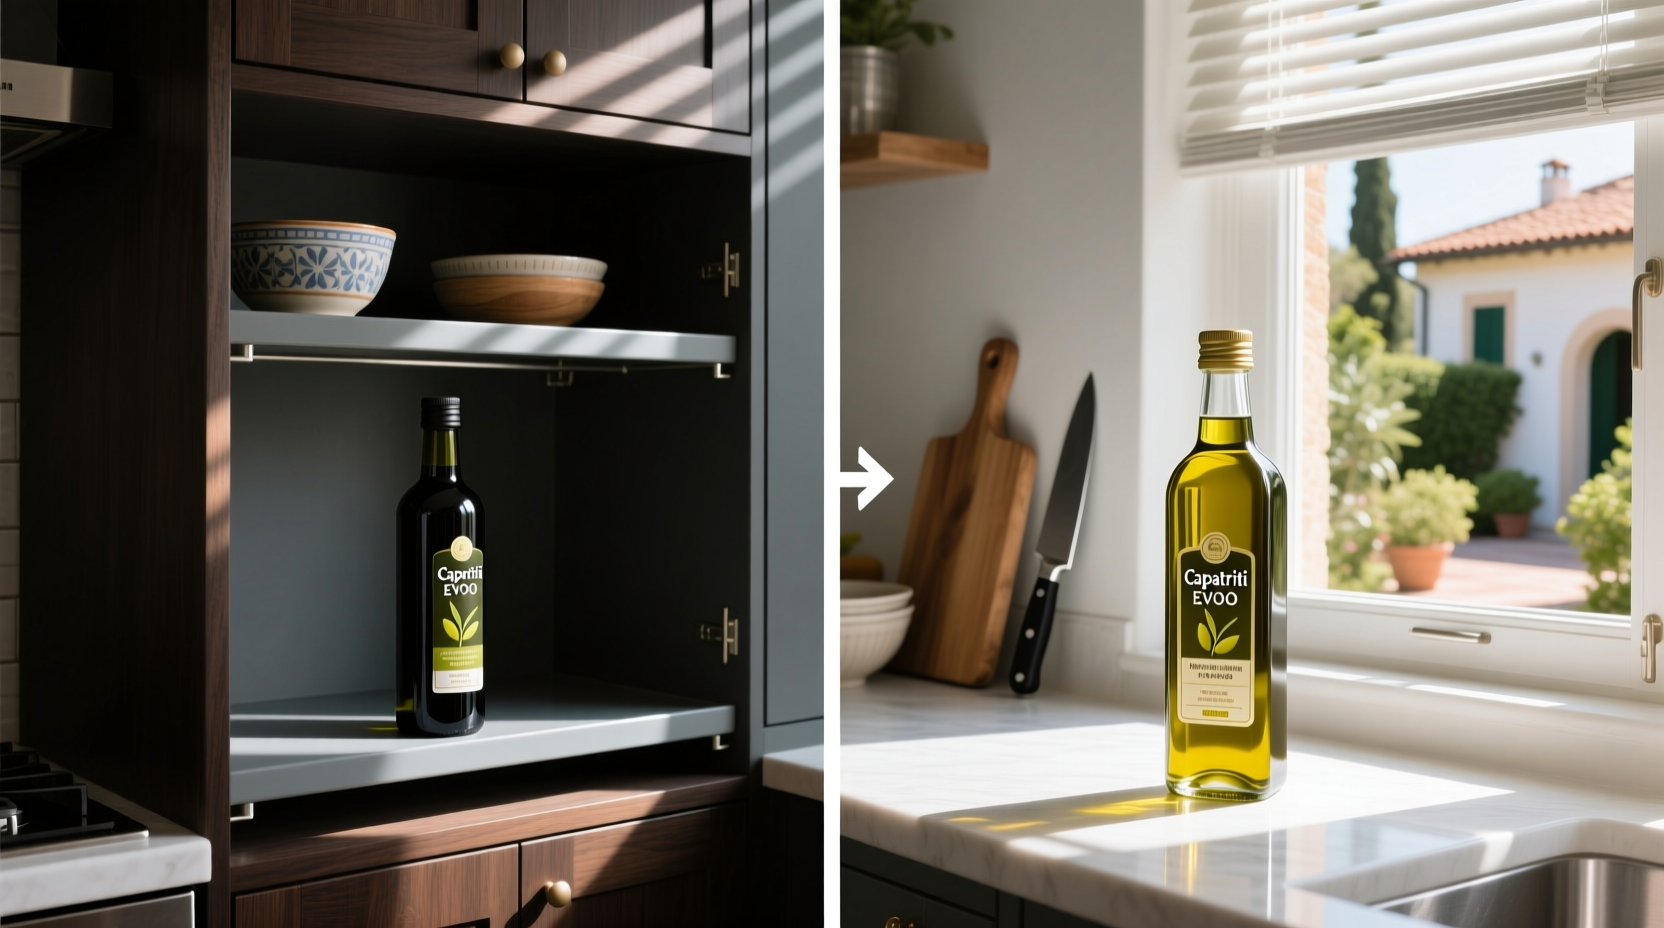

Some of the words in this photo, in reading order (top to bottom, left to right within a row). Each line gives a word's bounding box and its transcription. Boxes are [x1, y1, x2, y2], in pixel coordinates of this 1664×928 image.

[1184, 568, 1248, 590] Capatriti
[443, 582, 478, 597] EVOO
[1192, 590, 1239, 606] EVOO
